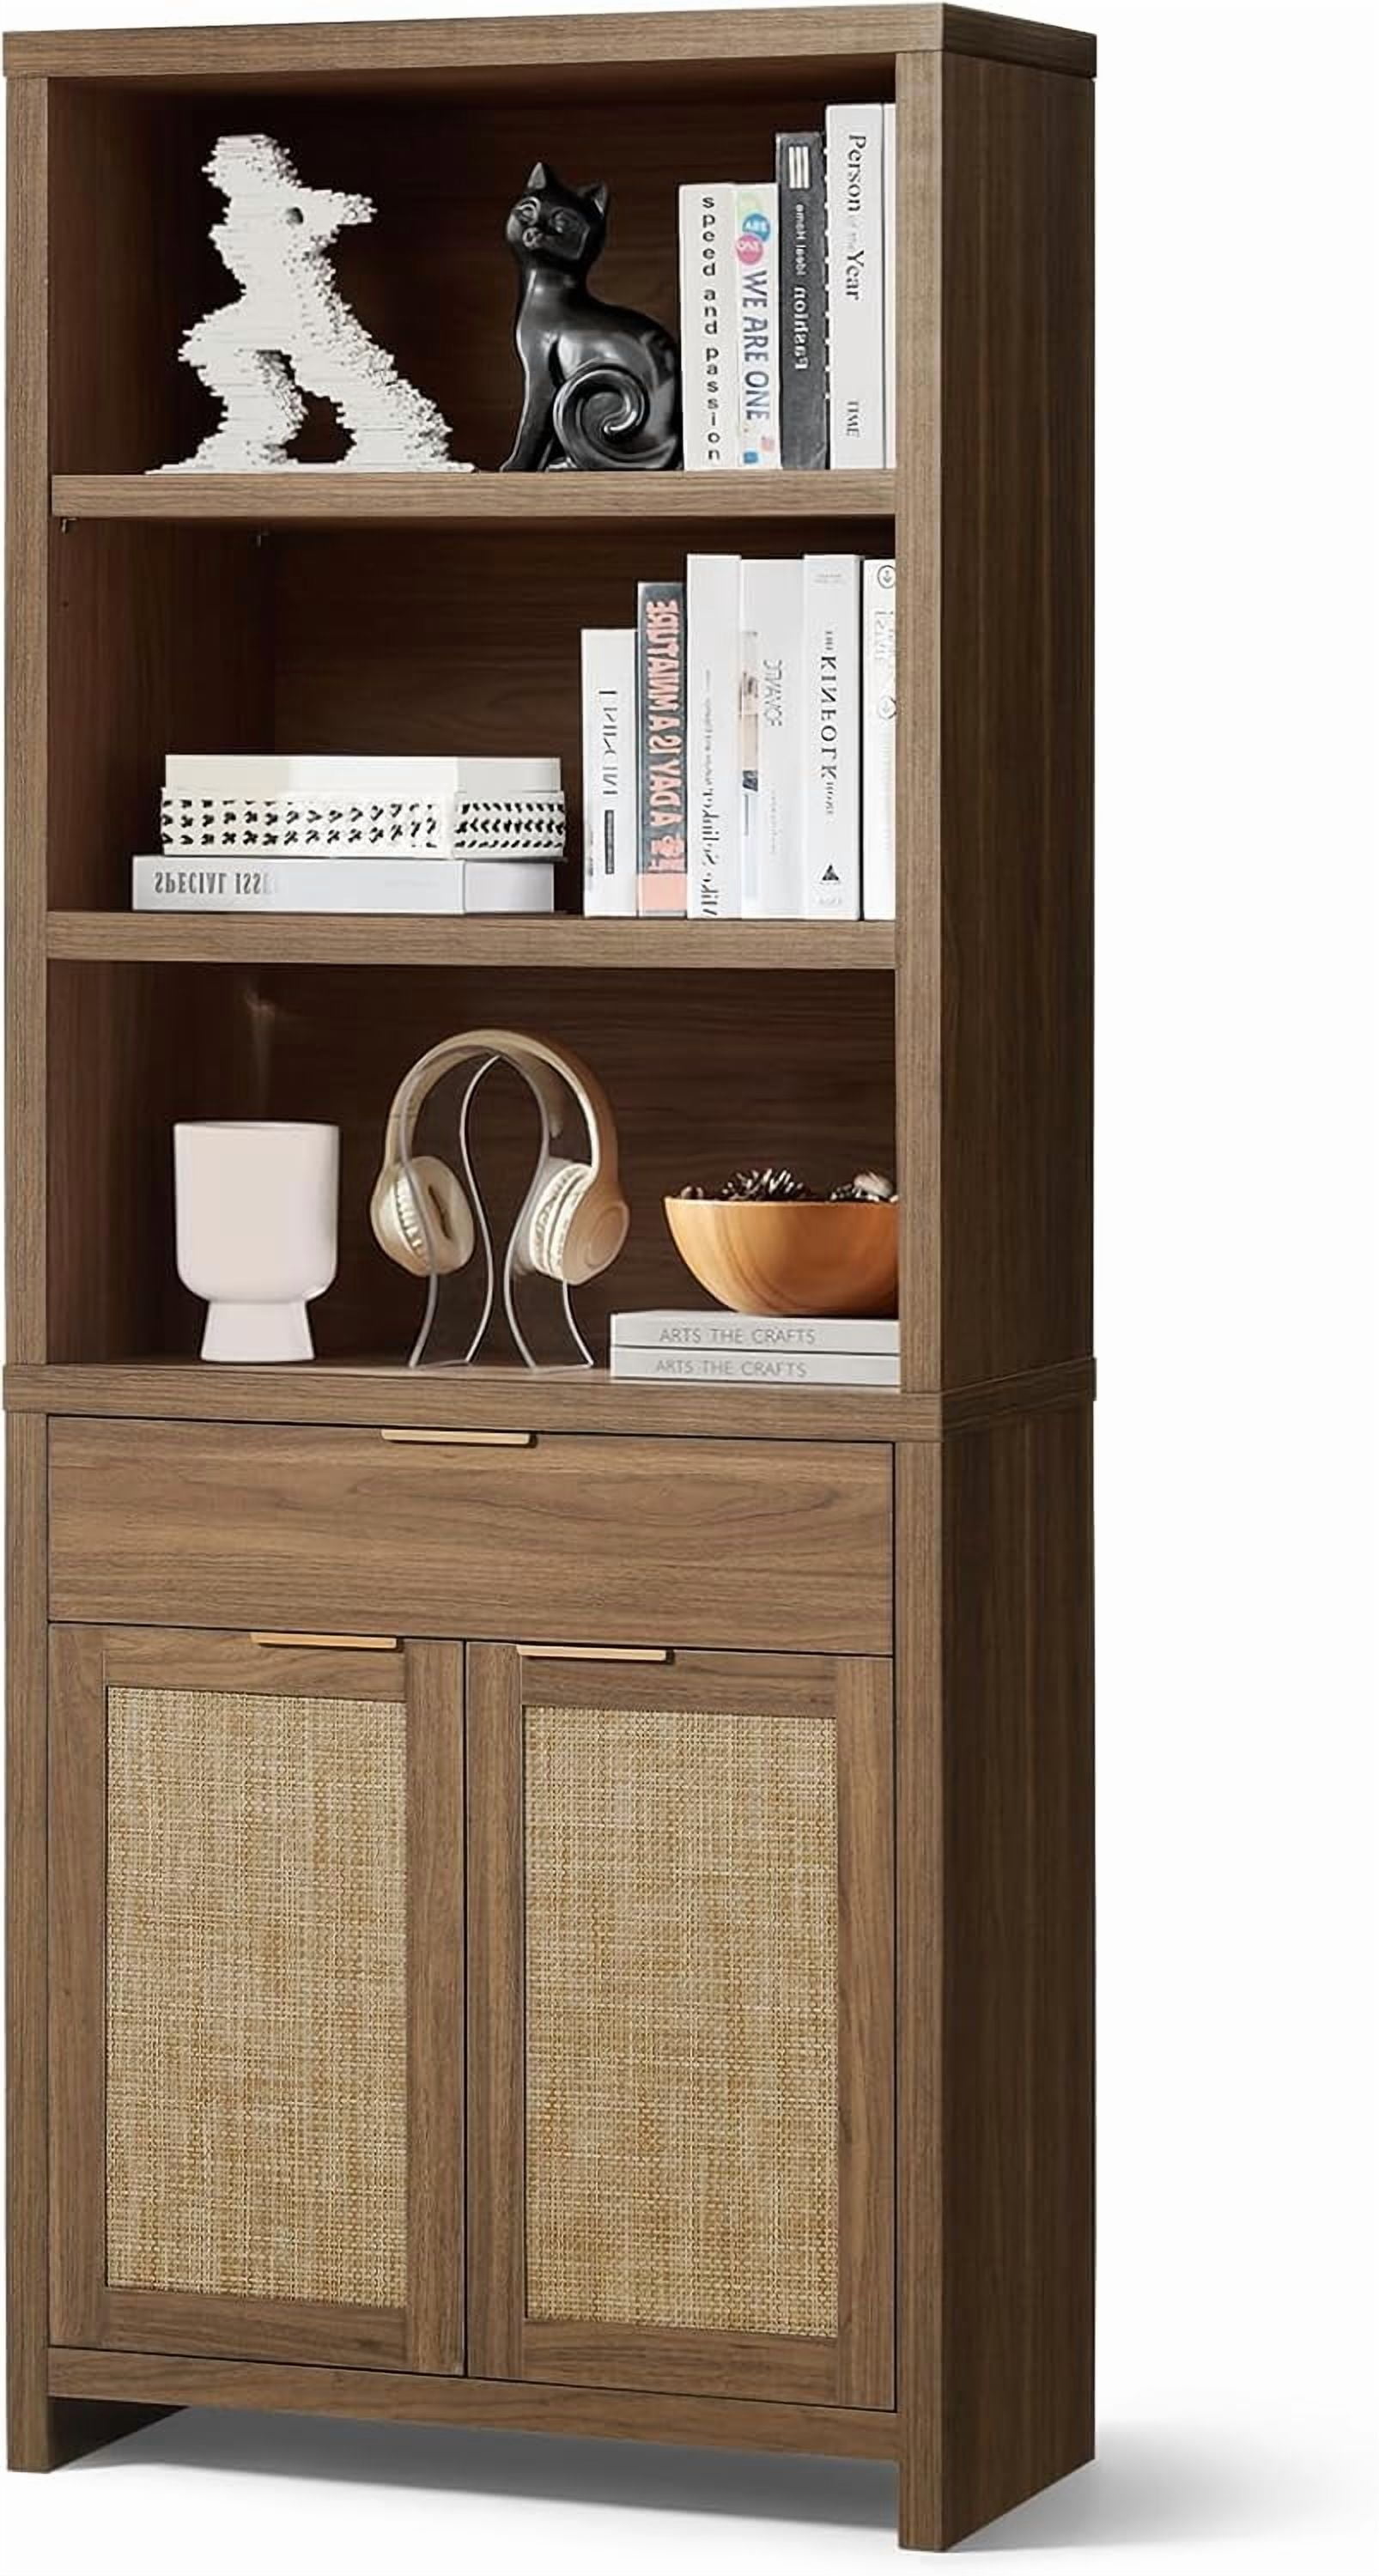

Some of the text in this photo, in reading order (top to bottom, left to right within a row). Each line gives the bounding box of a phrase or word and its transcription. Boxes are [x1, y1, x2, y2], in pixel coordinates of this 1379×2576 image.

[846, 135, 866, 212] Person
[846, 250, 866, 301] Year
[702, 197, 720, 460] speed and passion
[743, 269, 769, 421] WE ARE ONE
[656, 1360, 807, 1377] ARTS THE CRAFTS
[659, 1328, 815, 1345] ARTS THE CRAFTS
